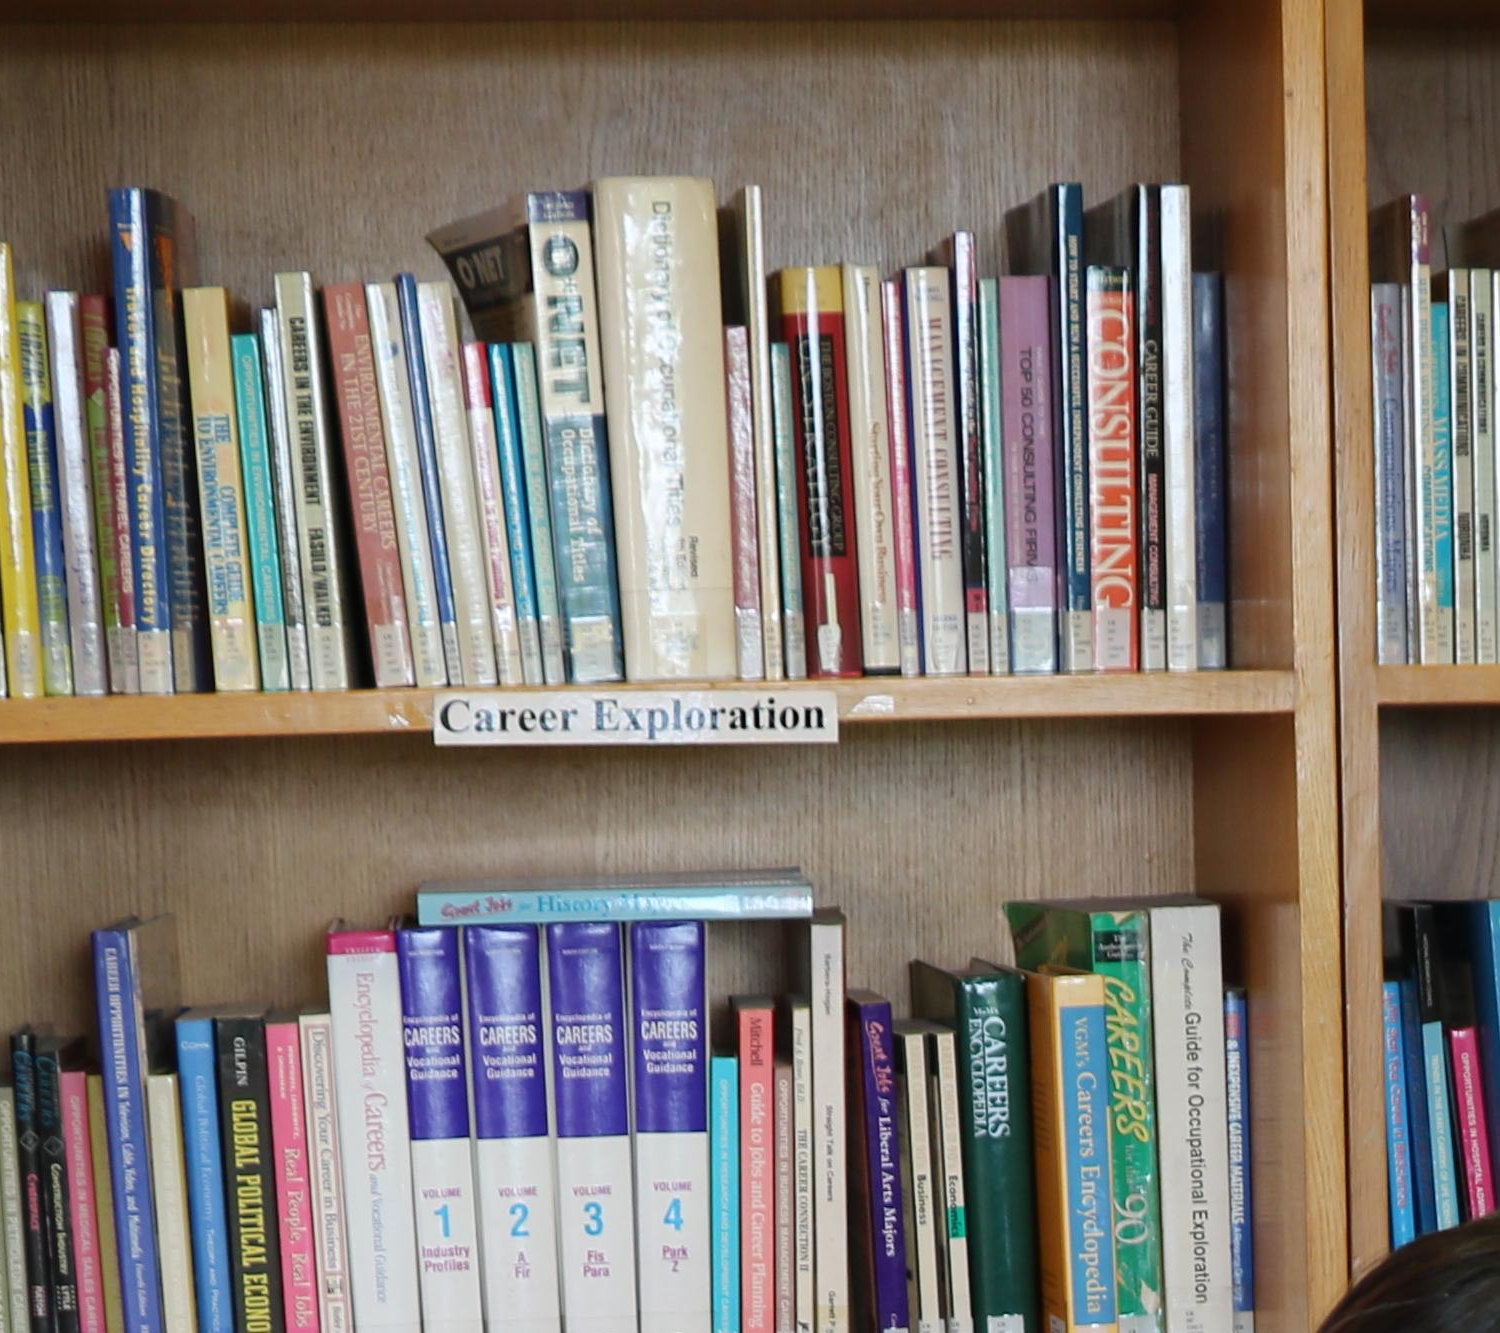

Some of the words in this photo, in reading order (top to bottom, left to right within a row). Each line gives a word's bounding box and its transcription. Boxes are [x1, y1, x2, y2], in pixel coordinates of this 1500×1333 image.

[340, 353, 358, 369] IN
[1145, 340, 1158, 401] CAREER
[343, 375, 363, 408] THE
[348, 415, 369, 450] 21ST
[352, 335, 388, 470] ENVIRONMENTAL
[372, 476, 399, 549] CAREERS
[1146, 406, 1158, 457] GUIDE
[353, 456, 380, 533] CENTURY
[439, 699, 578, 733] Career
[592, 697, 826, 739] Exploration
[404, 1027, 461, 1045] CAREERS
[480, 1025, 537, 1044] CAREERS
[557, 1025, 613, 1044] CAREERS
[642, 1021, 697, 1040] CAREERS
[1184, 1012, 1202, 1060] Guide
[407, 1056, 460, 1068] Vocational
[483, 1055, 537, 1067] Vocational
[559, 1054, 612, 1066] Vocational
[643, 1049, 696, 1061] Vocational
[646, 1062, 694, 1074] Guidance
[1104, 975, 1150, 1143] CAREERS
[411, 1068, 458, 1080] Guidance
[487, 1067, 534, 1079] Guidance
[563, 1066, 610, 1078] Guidance
[968, 1018, 987, 1139] ENCYCLOPEDIA
[983, 1016, 1011, 1138] CAREERS
[1186, 1067, 1203, 1089] for
[750, 1083, 764, 1122] Guide
[1075, 1072, 1099, 1157] Careers
[230, 1100, 260, 1167] GLOBAL
[751, 1128, 764, 1142] to
[748, 1147, 764, 1176] Jobs
[1187, 1094, 1208, 1204] Occupational
[422, 1187, 462, 1197] VOLUME
[498, 1186, 538, 1197] VOLUME
[572, 1185, 612, 1196] VOLUME
[653, 1181, 693, 1191] VOLUME
[751, 1181, 764, 1208] and
[918, 1174, 927, 1226] Business
[234, 1174, 265, 1266] POLITICAL
[434, 1204, 451, 1238] 1
[509, 1203, 530, 1238] 2
[583, 1202, 604, 1236] 3
[663, 1198, 684, 1231] 4
[751, 1212, 765, 1257] Career
[1075, 1165, 1108, 1314] Encyclopedia
[422, 1246, 470, 1262] Industry
[424, 1258, 470, 1273] Profiles
[587, 1249, 606, 1263] Fis
[662, 1245, 688, 1260] Park
[1190, 1210, 1212, 1304] Exploration
[514, 1265, 531, 1279] Fir
[583, 1264, 610, 1277] Para
[749, 1262, 765, 1328] Planning
